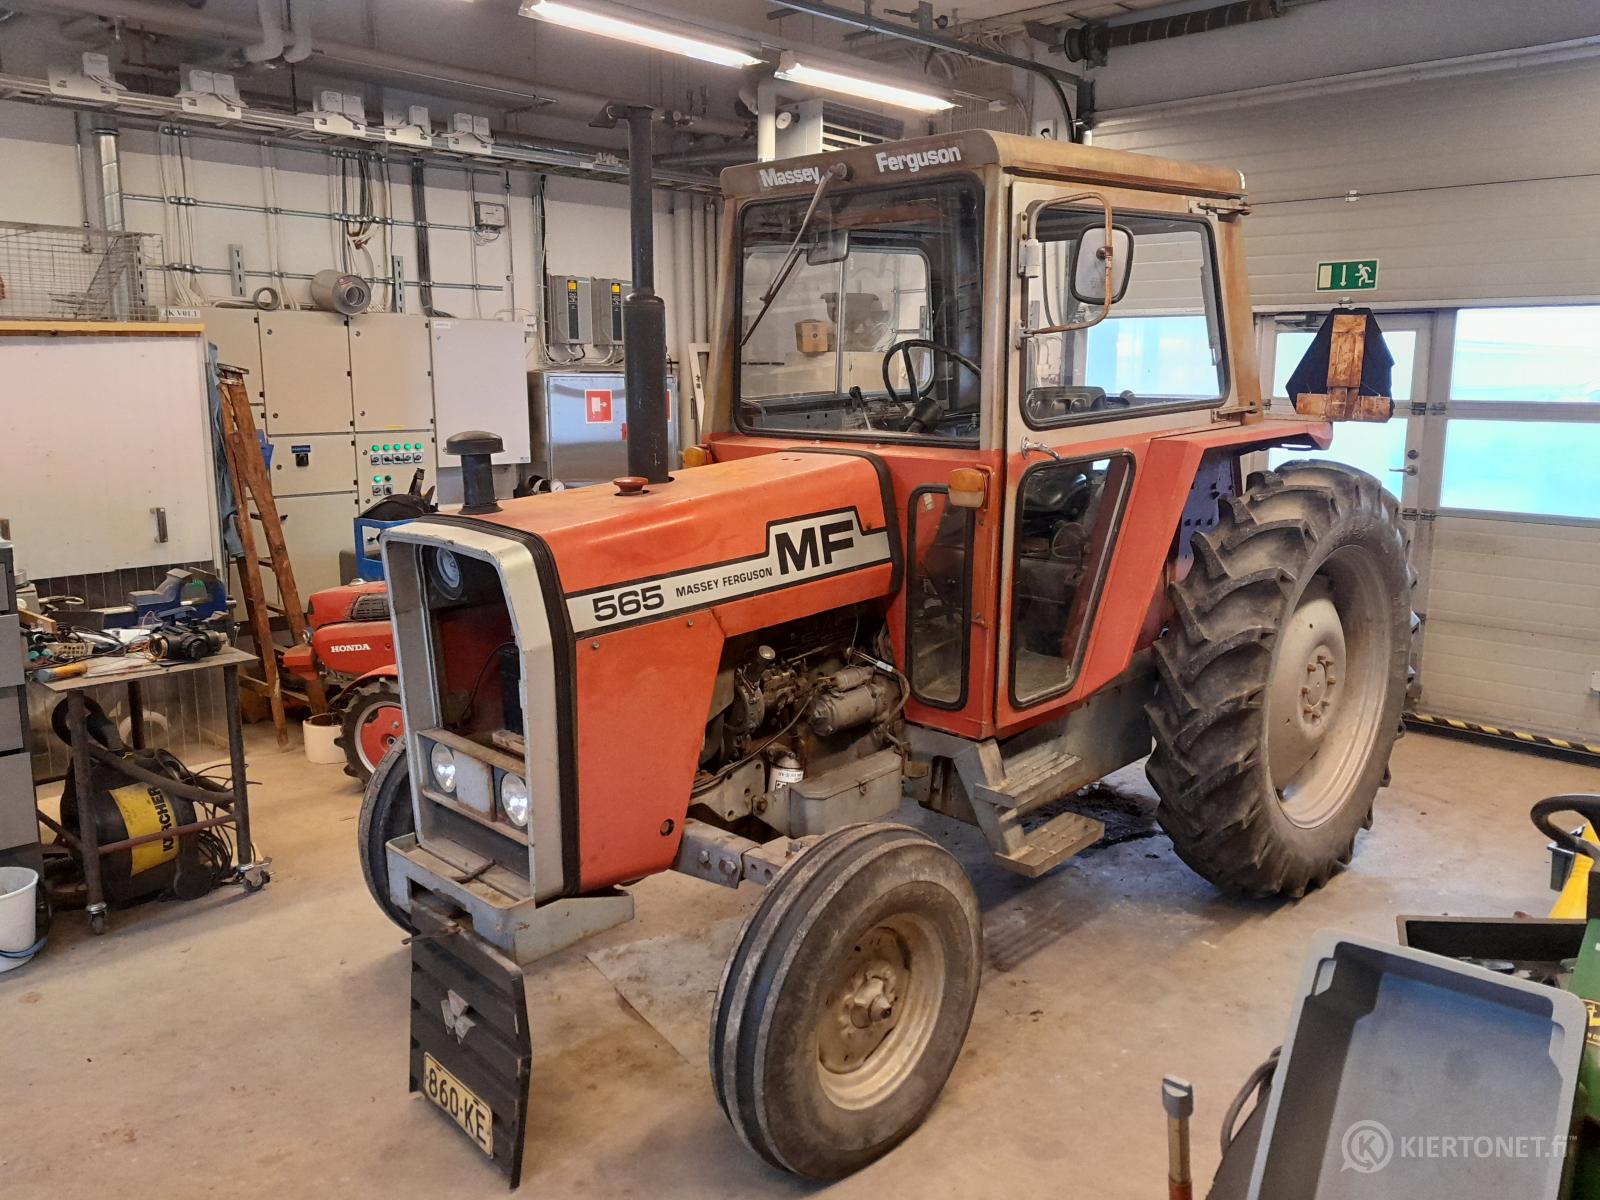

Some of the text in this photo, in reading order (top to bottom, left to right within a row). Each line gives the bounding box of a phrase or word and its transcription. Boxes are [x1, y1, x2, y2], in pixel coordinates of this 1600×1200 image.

[759, 146, 962, 188] Massey Ferguson
[592, 519, 855, 621] 565 MASSEY FERGUSON MF
[330, 643, 371, 653] HONDA
[147, 784, 174, 853] KRCHER
[428, 1067, 487, 1145] 860-KE
